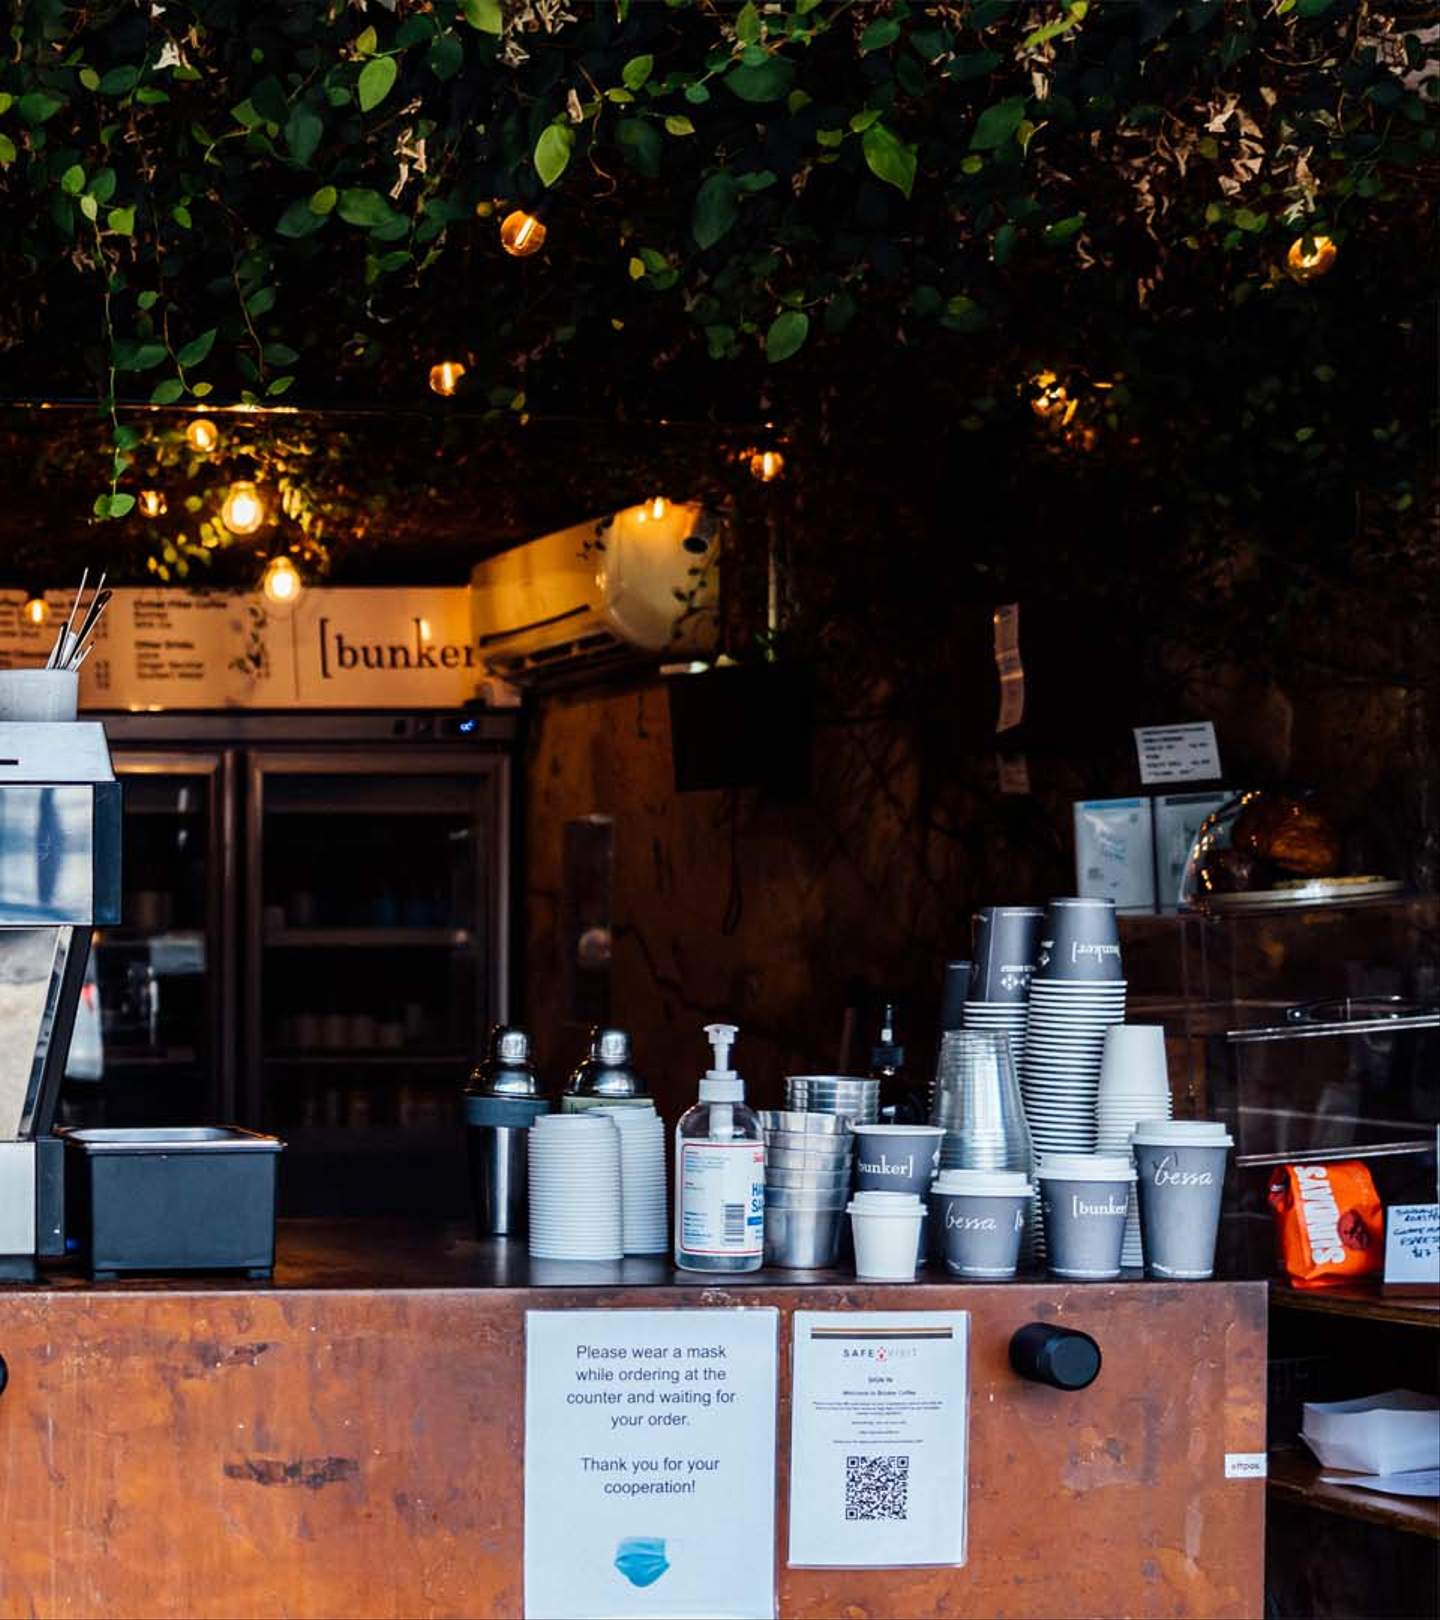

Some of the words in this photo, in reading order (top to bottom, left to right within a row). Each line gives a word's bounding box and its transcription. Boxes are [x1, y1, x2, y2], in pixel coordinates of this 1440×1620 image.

[576, 1345, 627, 1359] Please
[632, 1347, 668, 1359] wear
[672, 1347, 683, 1359] a
[687, 1345, 727, 1359] mask
[843, 1349, 874, 1358] SAFE
[576, 1368, 614, 1381] while
[618, 1368, 680, 1384] ordering
[684, 1369, 698, 1381] at
[703, 1367, 727, 1381] the
[566, 1391, 622, 1404] counter
[627, 1390, 655, 1404] and
[659, 1390, 711, 1407] waiting
[716, 1389, 737, 1403] for
[610, 1415, 643, 1430] your
[648, 1413, 691, 1426] order.
[581, 1457, 627, 1472] Thank
[632, 1459, 659, 1475] you
[663, 1457, 683, 1471] for
[687, 1459, 720, 1474] your
[604, 1480, 696, 1496] cooperation!
